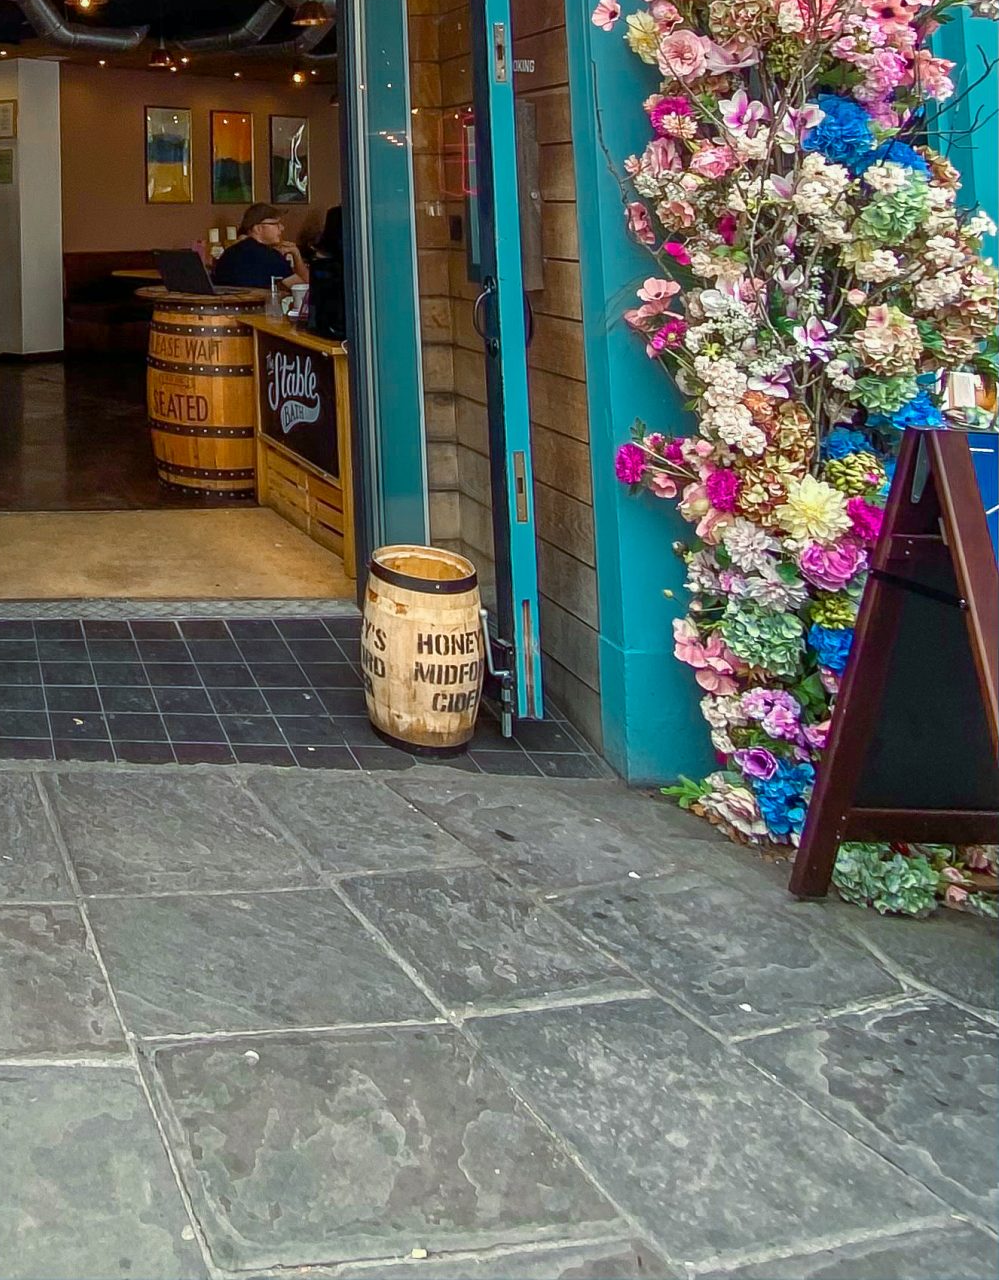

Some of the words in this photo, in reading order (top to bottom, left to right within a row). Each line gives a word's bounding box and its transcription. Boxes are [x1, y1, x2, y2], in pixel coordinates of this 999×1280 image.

[150, 332, 180, 359] LEASE
[185, 338, 222, 363] WAIT
[268, 351, 320, 411] Stable
[153, 388, 208, 422] SEATED
[284, 403, 305, 426] BATH
[362, 616, 387, 651] Y'S
[417, 630, 480, 656] HONEY
[414, 661, 482, 685] MIDFO
[432, 689, 479, 713] CIDE
